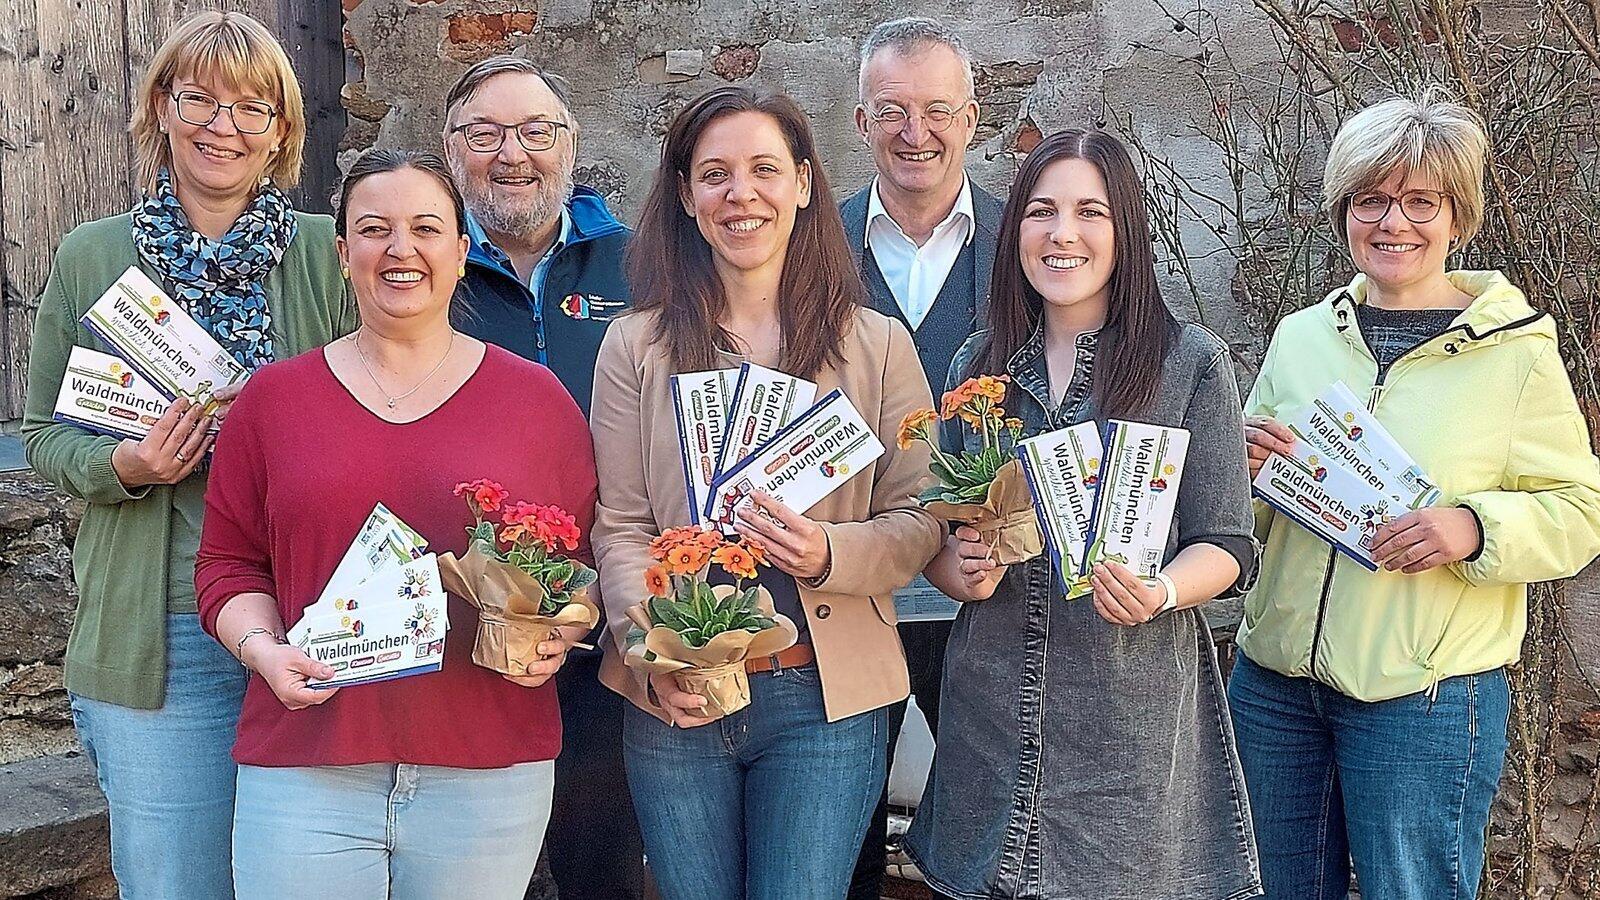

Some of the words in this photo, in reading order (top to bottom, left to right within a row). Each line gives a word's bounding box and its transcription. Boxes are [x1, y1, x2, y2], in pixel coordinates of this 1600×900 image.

[113, 297, 197, 378] Waldmünchen
[151, 355, 181, 380] gesund
[766, 421, 860, 492] Waldmünchen
[1309, 412, 1385, 491] Waldmünchen
[1120, 437, 1155, 544] Waldmünchen
[1270, 457, 1361, 526] Waldmünchen
[1057, 513, 1080, 544] gesund
[316, 634, 409, 660] Waldmünchen
